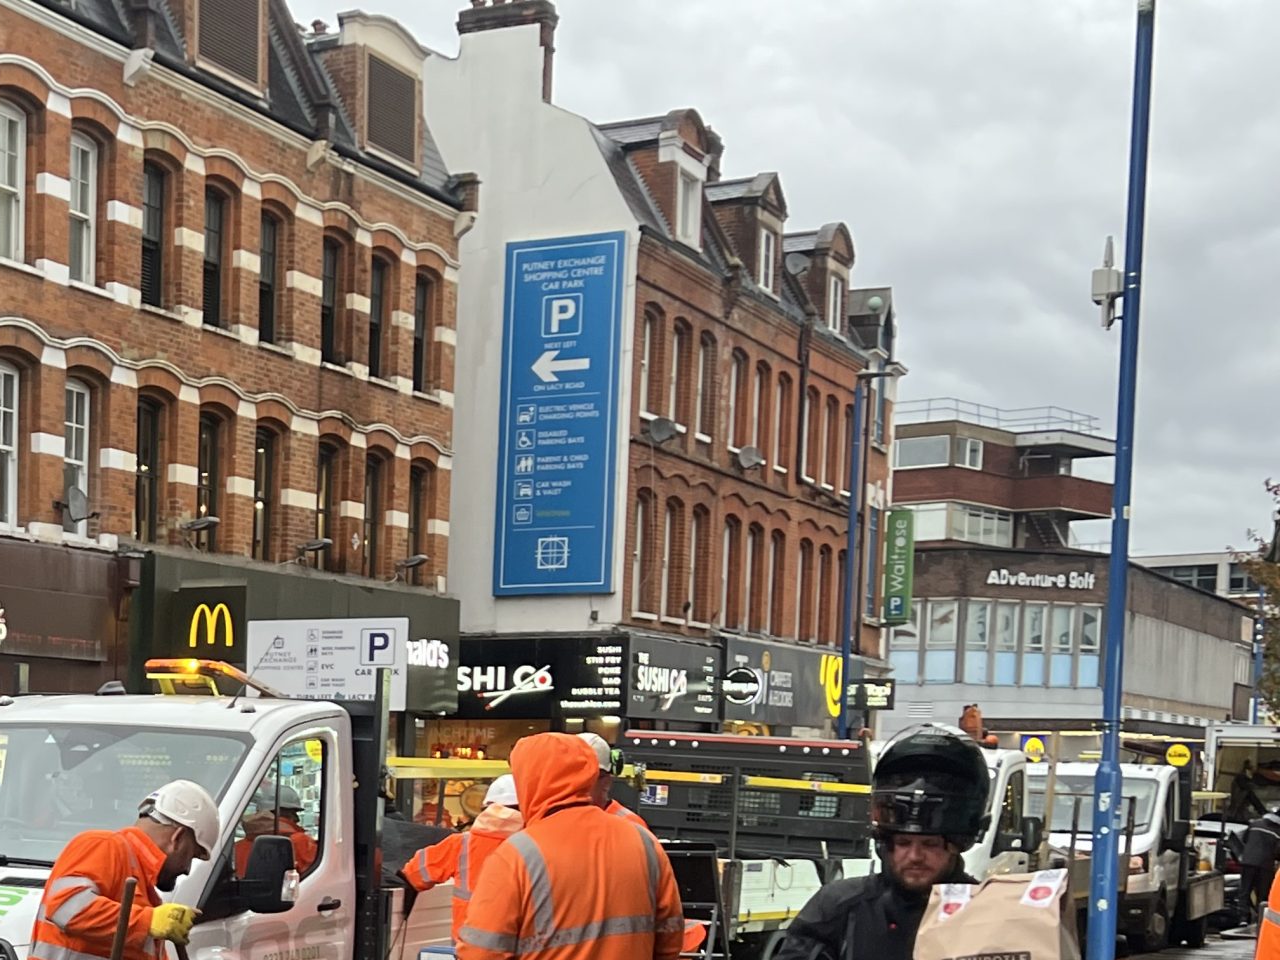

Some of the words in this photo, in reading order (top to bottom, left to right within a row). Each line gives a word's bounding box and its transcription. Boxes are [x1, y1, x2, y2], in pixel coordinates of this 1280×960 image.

[522, 261, 555, 271] PUTNEY
[557, 255, 606, 268] EXCHANGE
[524, 270, 568, 282] SHOPPING
[570, 266, 604, 277] CENTRE
[541, 281, 559, 291] CAR
[561, 279, 584, 289] PARK
[550, 298, 576, 333] P
[564, 381, 585, 389] ROAD
[890, 519, 907, 592] Waitrose
[369, 633, 389, 661] P
[407, 638, 449, 668] nald's
[354, 668, 372, 676] CAR
[457, 665, 506, 692] SHI
[637, 665, 669, 692] SUSHI
